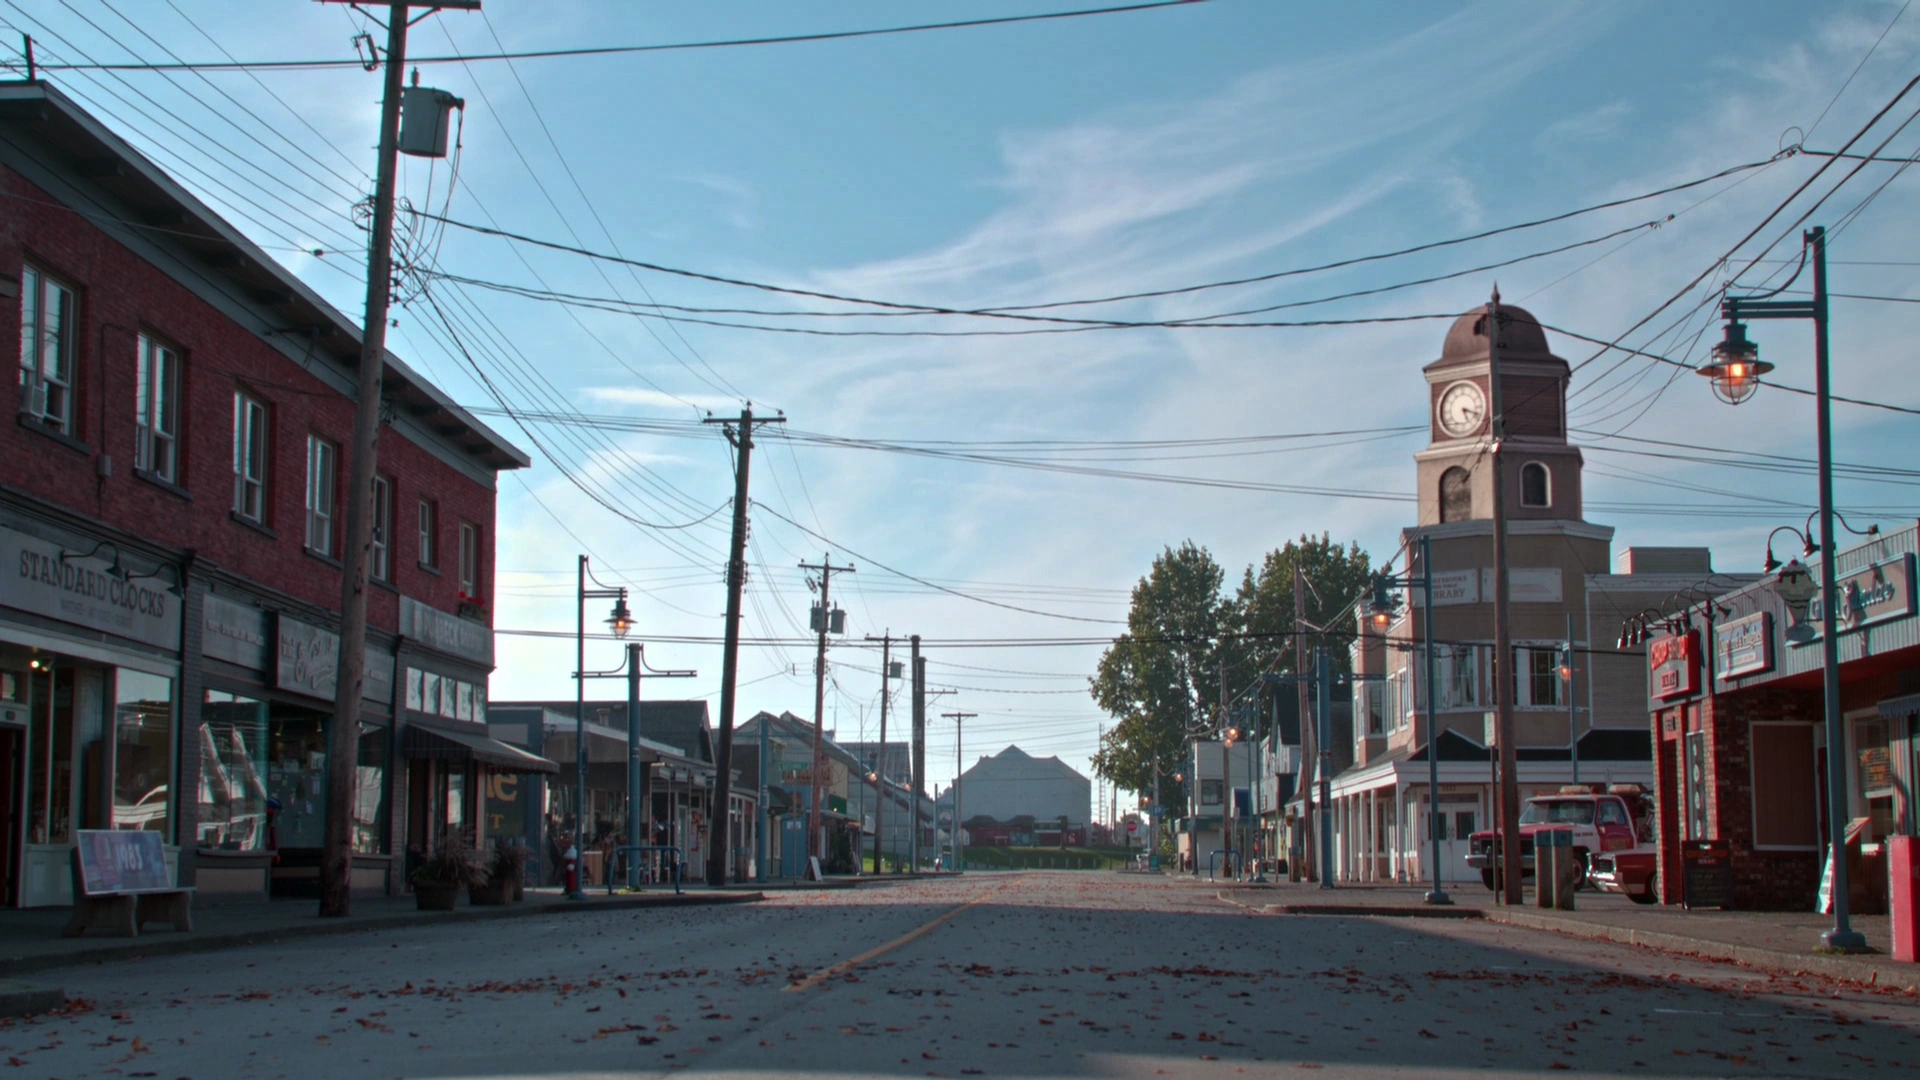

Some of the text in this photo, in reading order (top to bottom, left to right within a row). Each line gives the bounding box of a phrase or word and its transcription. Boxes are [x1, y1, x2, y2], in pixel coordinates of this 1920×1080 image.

[19, 549, 107, 600] STANDARD
[110, 577, 165, 618] CLOCKS
[1434, 588, 1465, 599] BRARY
